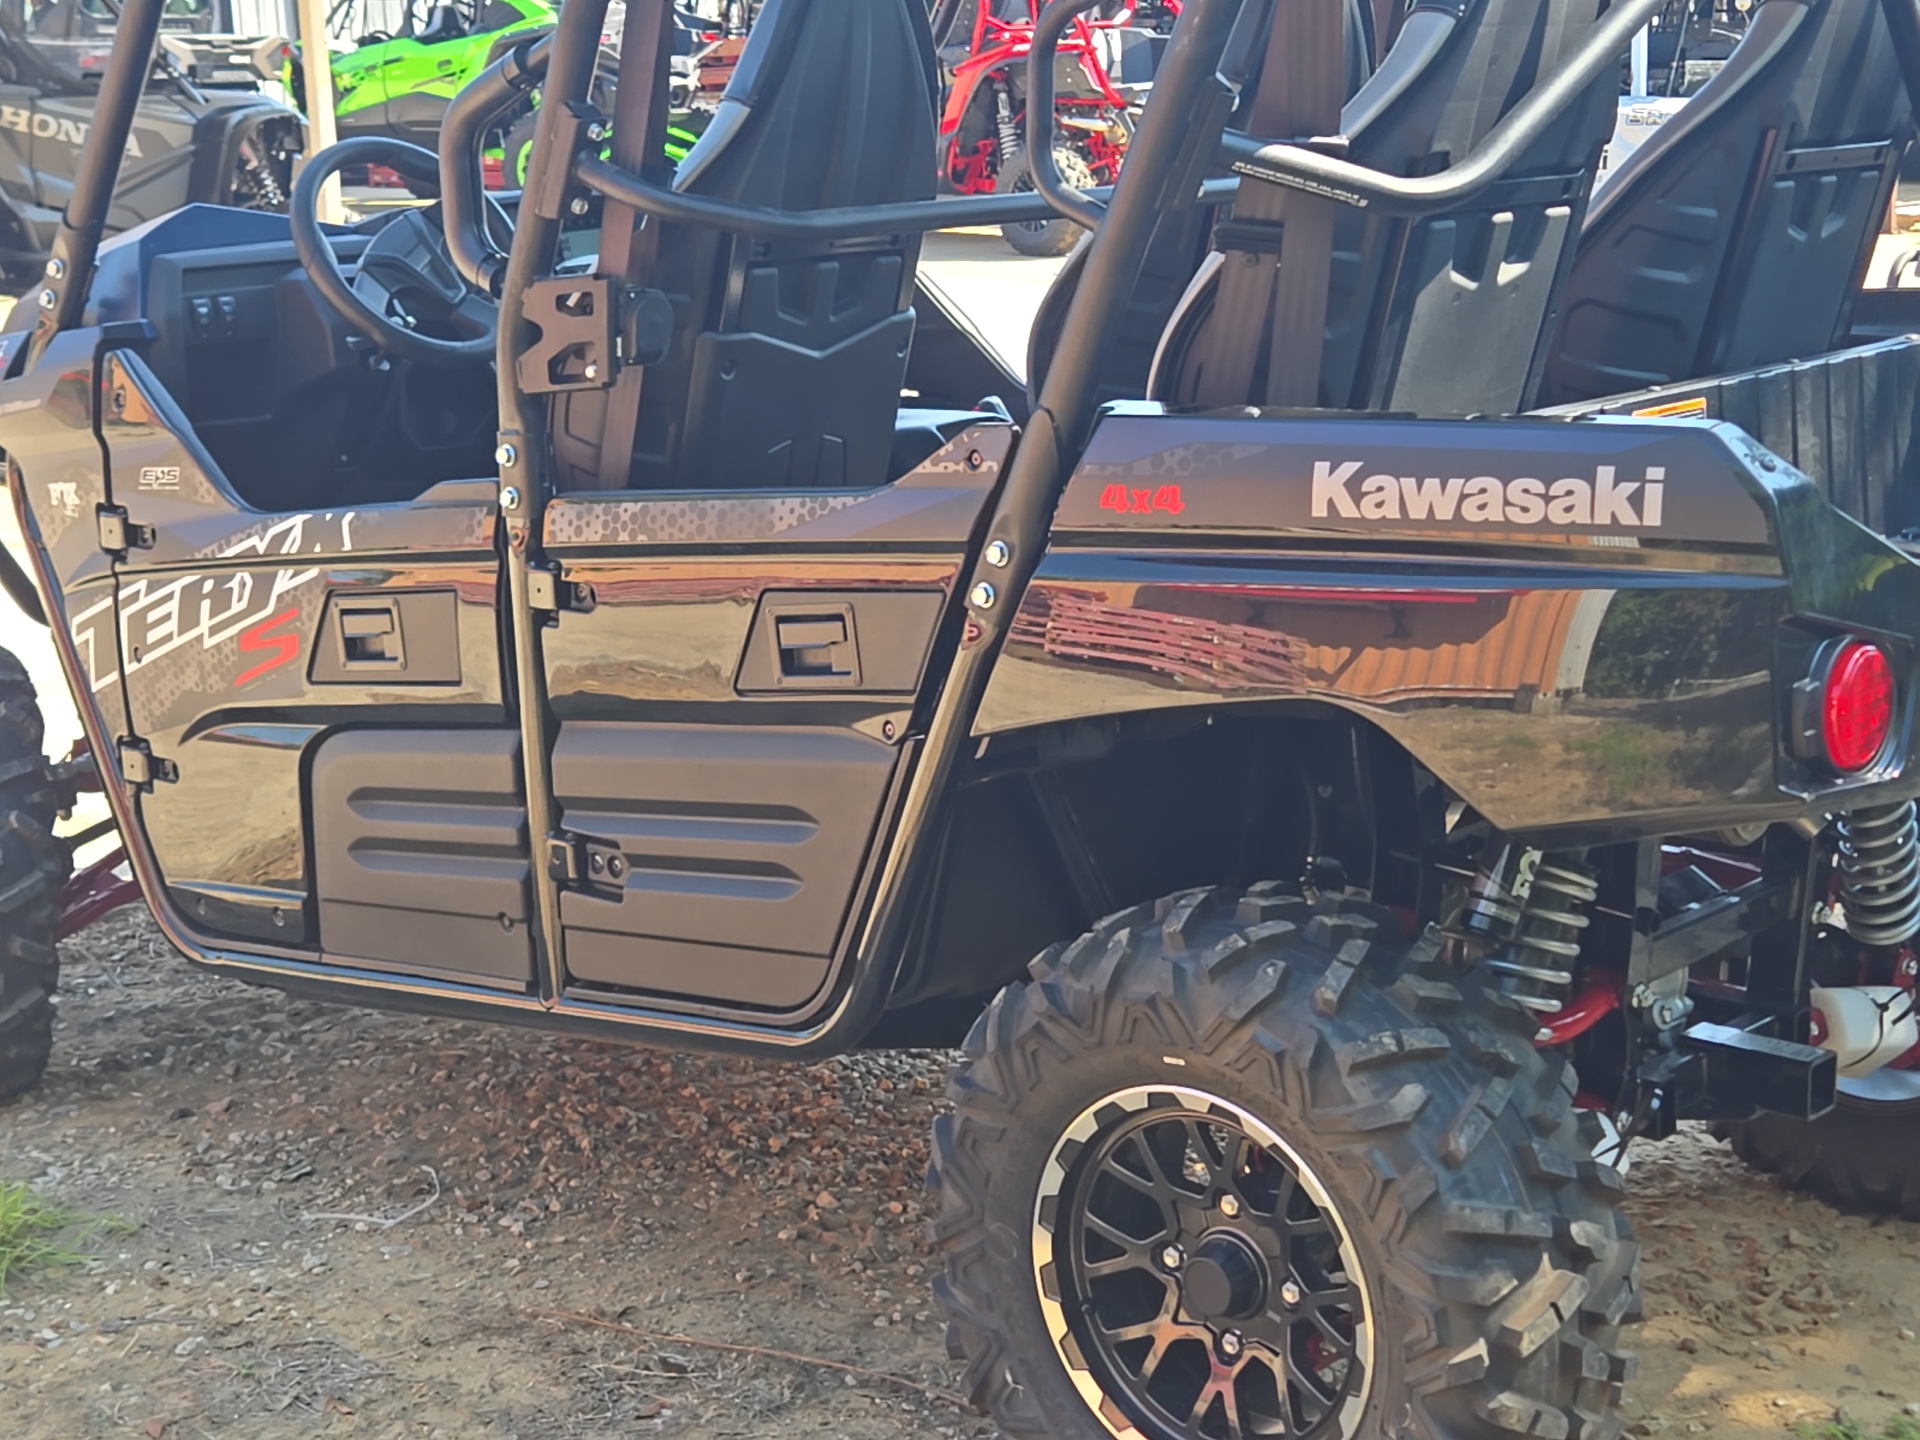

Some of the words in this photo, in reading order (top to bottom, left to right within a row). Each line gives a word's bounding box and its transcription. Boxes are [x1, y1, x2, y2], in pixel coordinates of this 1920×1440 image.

[0, 105, 144, 158] HONA
[139, 467, 180, 487] EPS
[1100, 485, 1184, 515] 4x4
[1311, 461, 1665, 527] Kawasaki
[233, 608, 299, 688] S
